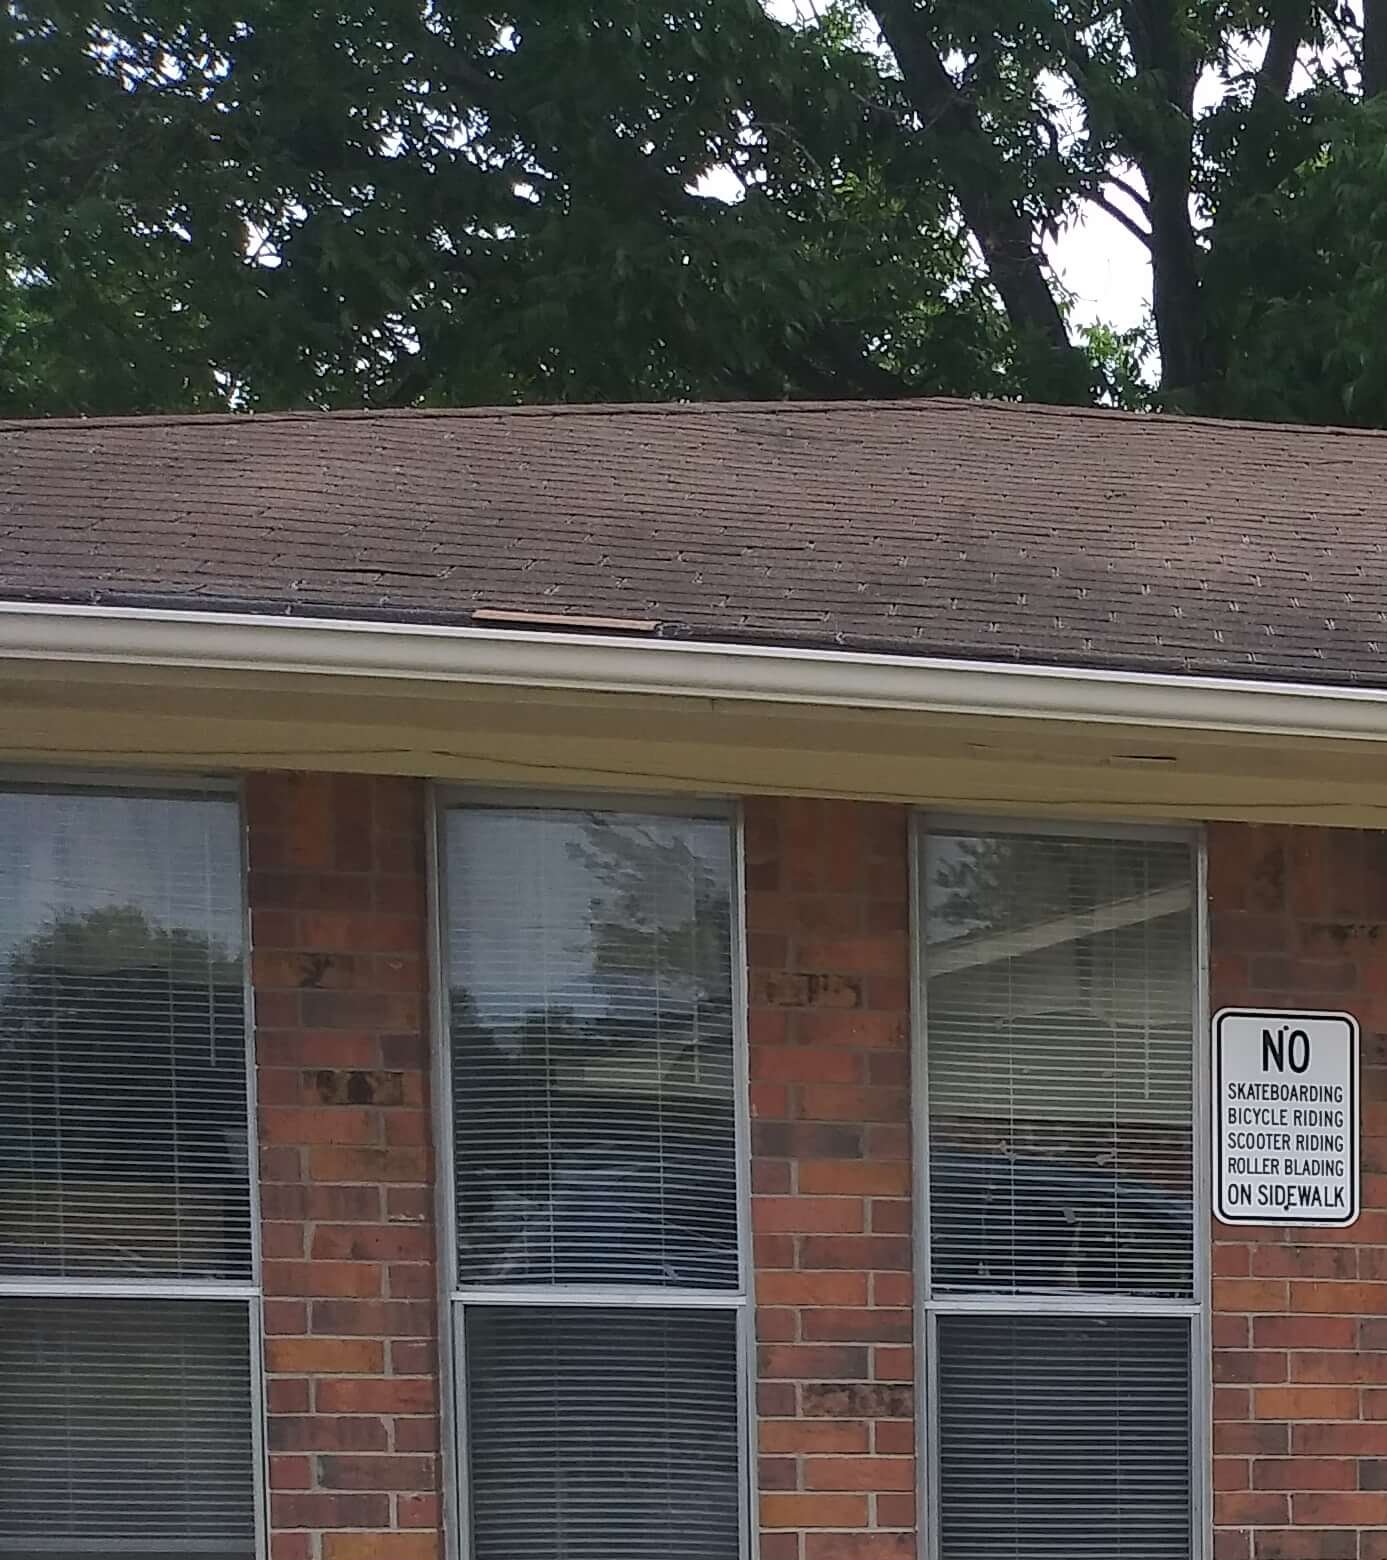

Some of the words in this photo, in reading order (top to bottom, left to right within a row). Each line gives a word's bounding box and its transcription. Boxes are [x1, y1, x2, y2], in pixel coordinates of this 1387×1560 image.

[1262, 1029, 1310, 1073] NO
[1228, 1083, 1343, 1103] SKATEBOARDING
[1228, 1108, 1288, 1126] BICYCLE
[1294, 1109, 1344, 1128] RIDING
[1228, 1132, 1291, 1150] SCOOTER
[1296, 1134, 1344, 1152] RIDING
[1228, 1157, 1280, 1175] ROLLER
[1284, 1159, 1344, 1177] BLADING
[1228, 1183, 1252, 1206] ON
[1257, 1184, 1345, 1208] SIDEWALK
